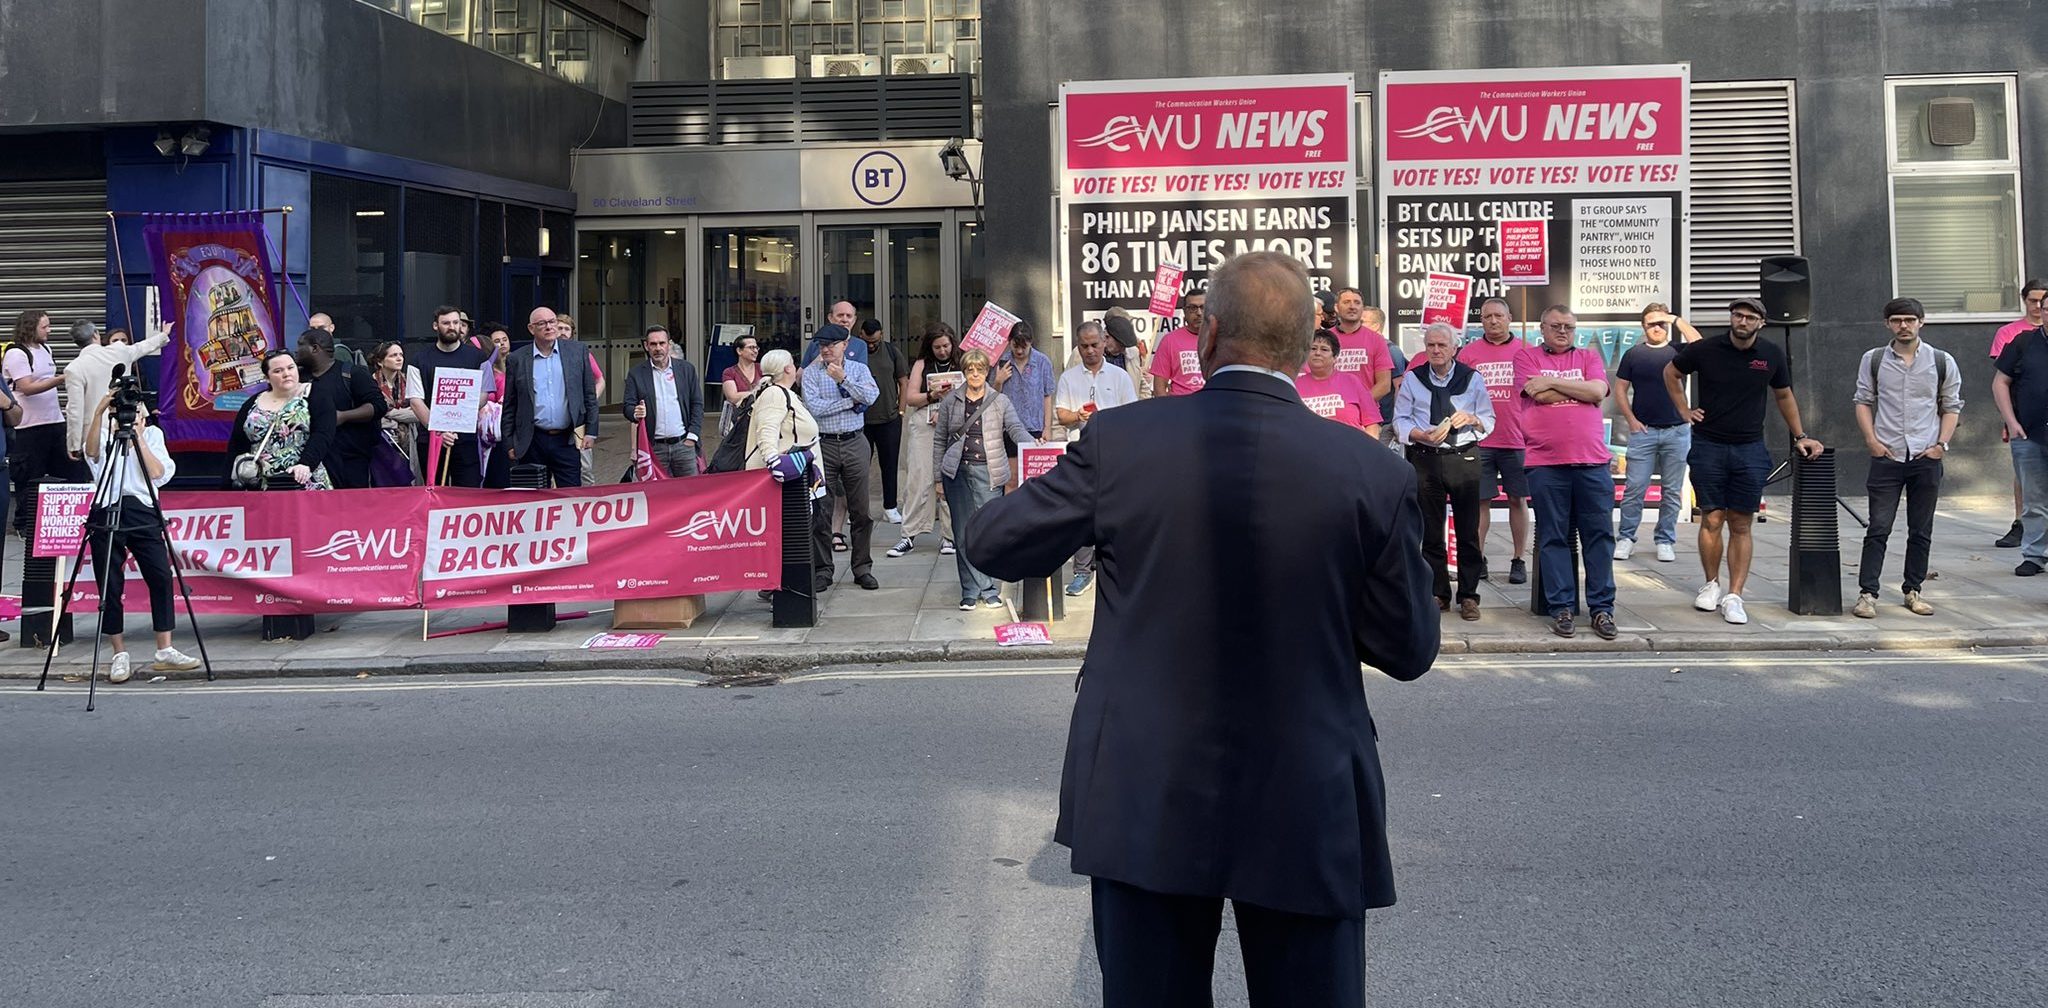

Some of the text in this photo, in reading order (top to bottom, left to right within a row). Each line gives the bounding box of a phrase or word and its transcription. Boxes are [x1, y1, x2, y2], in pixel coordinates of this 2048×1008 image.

[1492, 90, 1540, 98] Communication
[1426, 102, 1662, 143] CWU NEWS
[1104, 110, 1328, 152] CWU NEWS
[1636, 143, 1654, 151] FREE
[1304, 150, 1322, 158] FREE
[864, 168, 894, 188] BT
[1392, 164, 1679, 186] VOTE YES! VOTE YES! VOTE YES!
[1073, 170, 1346, 194] VOTE YES! VOTE YES! VOTE YES!
[609, 197, 662, 208] Cleveland
[665, 196, 696, 206] Street
[1398, 201, 1554, 222] BT CALL CENTRE
[1581, 205, 1648, 214] BT GROUP SAYS
[1082, 206, 1331, 238] PHILIP JANSEN EARNS
[1581, 220, 1596, 228] THE
[1398, 228, 1442, 248] SETS
[1448, 228, 1474, 246] UP
[1624, 232, 1654, 240] WHICH
[1580, 244, 1652, 254] OFFERS FOOD TO
[1081, 241, 1120, 274] 86
[1127, 239, 1226, 272] TIMES
[1465, 252, 1501, 272] FOR
[1580, 258, 1656, 268] THOSE WHO NEED
[1650, 271, 1660, 280] BE
[1082, 280, 1134, 299] THAN
[1430, 280, 1462, 288] OFFICIAL
[1580, 284, 1660, 294] CONFUSED WITH A
[1430, 286, 1446, 294] CWU
[1428, 294, 1454, 302] PICKET
[1580, 298, 1604, 307] FOOD
[43, 494, 88, 504] SUPPORT
[42, 505, 76, 516] THE BT
[440, 498, 634, 540] HONK IF YOU
[689, 506, 766, 540] CWU
[40, 526, 80, 538] STRIKES
[166, 514, 234, 541] RIKE
[328, 528, 412, 560] CWU
[699, 542, 748, 552] communications
[217, 546, 280, 572] PAY
[438, 536, 576, 573] BACK US!
[338, 564, 389, 573] communications
[693, 574, 720, 583] #TheCWU
[534, 584, 578, 592] Communications
